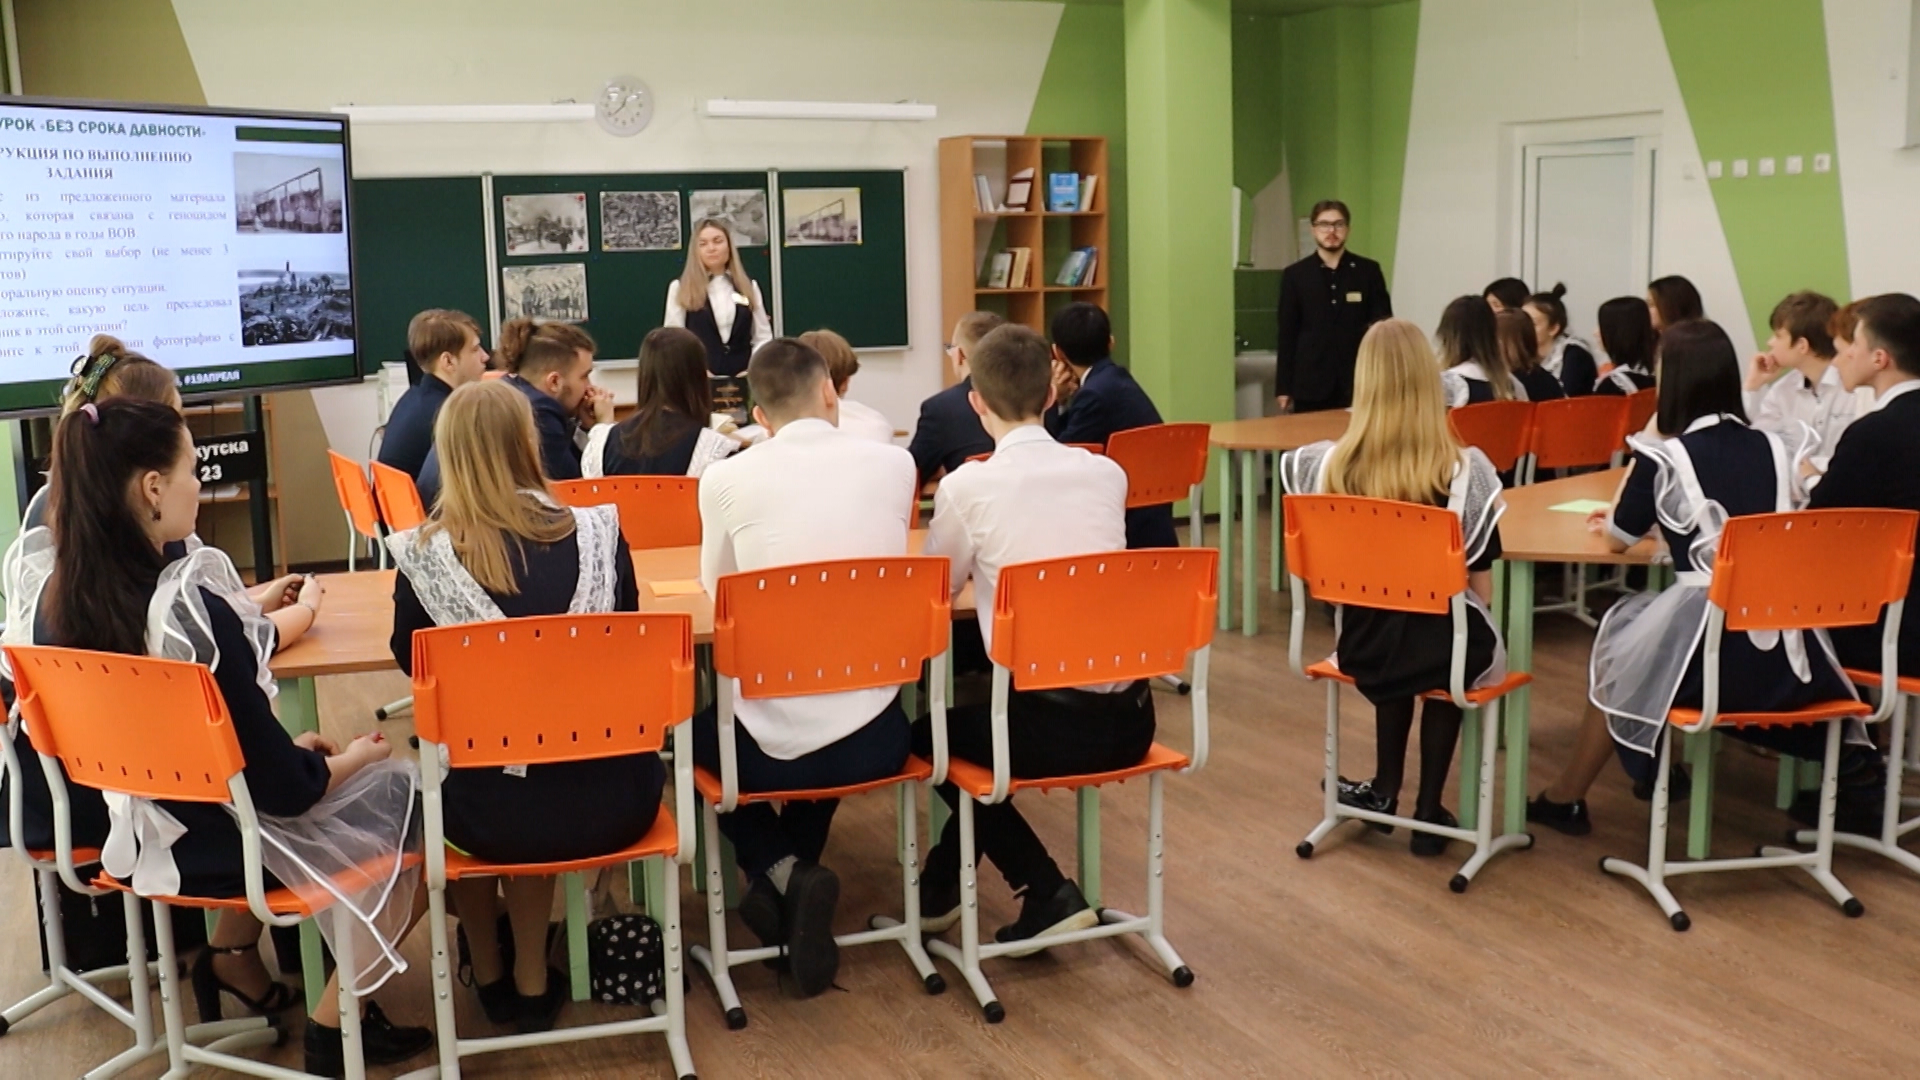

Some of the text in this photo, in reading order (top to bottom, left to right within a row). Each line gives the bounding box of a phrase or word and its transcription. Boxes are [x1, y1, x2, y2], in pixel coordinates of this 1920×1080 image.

[79, 121, 126, 135] СРОКА
[63, 149, 84, 160] ПО
[88, 149, 192, 163] ВЫПОЛНЕНИЮ
[47, 167, 113, 179] ЗАДАНИЯ
[25, 193, 226, 205] из предложенного материала
[25, 212, 74, 223] которая
[89, 211, 134, 221] связана
[147, 211, 155, 221] с
[168, 211, 227, 220] геноцидом
[17, 231, 61, 243] народа
[64, 231, 72, 240] в
[75, 231, 104, 240] годы
[64, 246, 93, 258] свой
[104, 245, 142, 260] выбор
[151, 245, 169, 257] (не
[180, 246, 213, 256] менее
[66, 285, 108, 297] оценку
[68, 304, 106, 317] какую
[123, 302, 149, 313] цель
[166, 299, 233, 312] преследовал
[25, 327, 32, 336] в
[38, 324, 63, 336] этой
[66, 319, 127, 335] ситуации?
[34, 345, 42, 354] к
[52, 341, 80, 353] этой
[152, 332, 221, 349] фотографию
[228, 333, 235, 342] с
[184, 370, 240, 385] #19АПРЕЛЯ
[200, 464, 222, 482] 23
